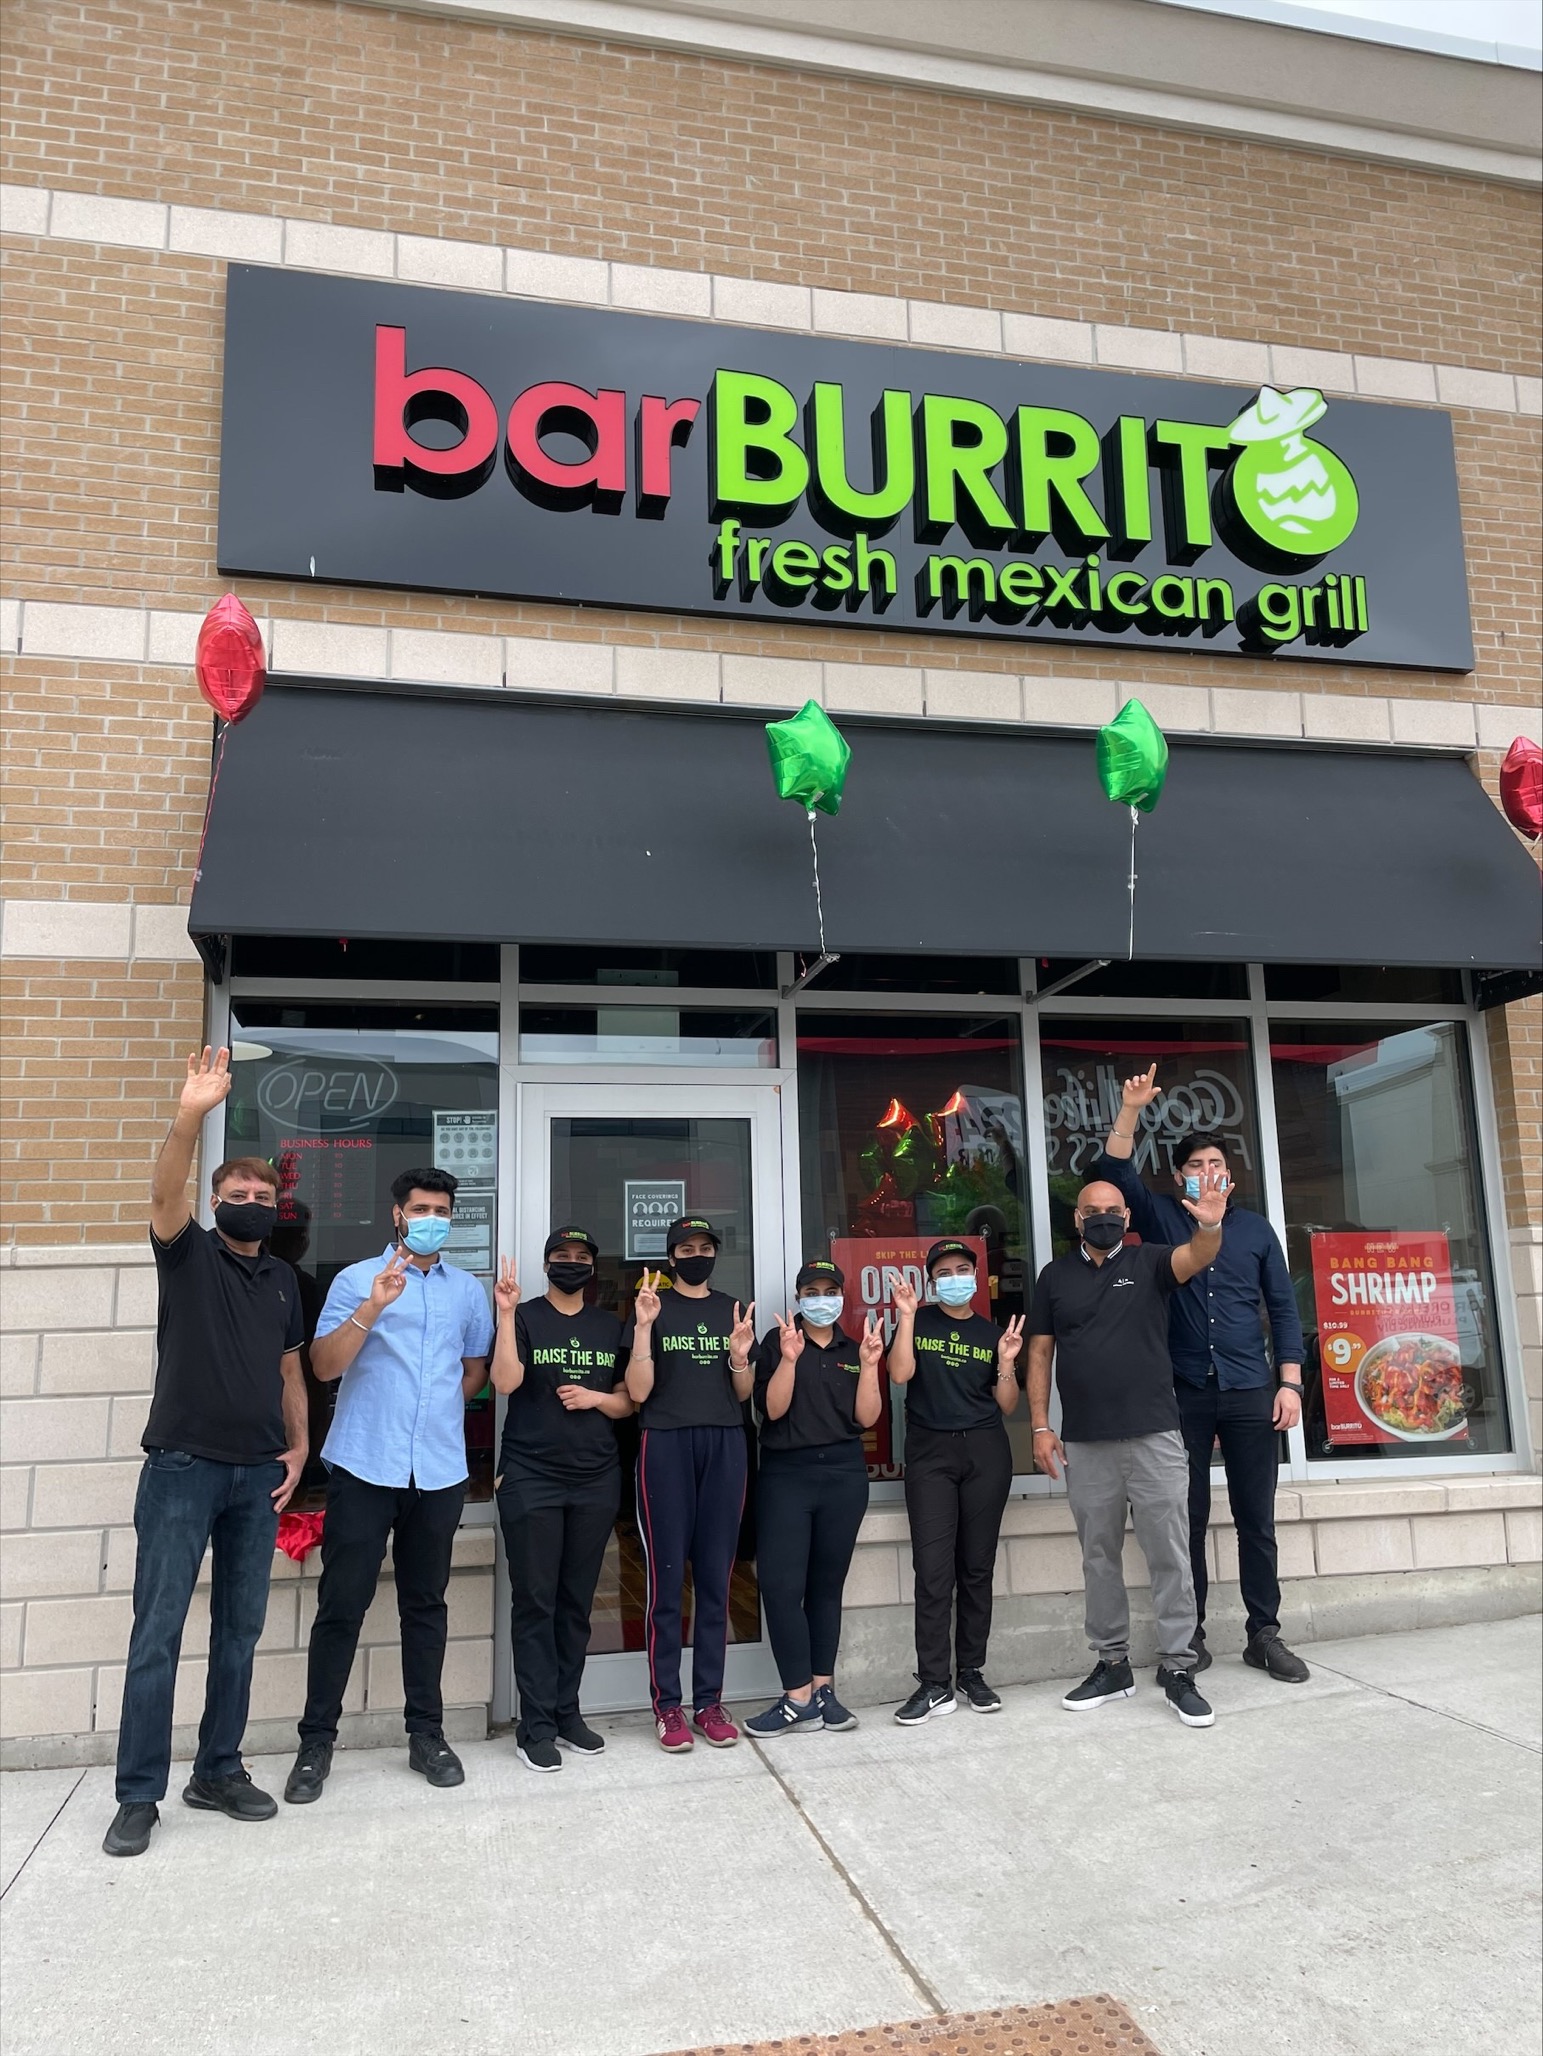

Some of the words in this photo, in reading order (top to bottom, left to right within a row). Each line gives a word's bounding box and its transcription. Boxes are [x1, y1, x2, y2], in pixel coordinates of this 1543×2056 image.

[716, 518, 900, 594] fresh
[929, 554, 1235, 622] mexican
[1257, 573, 1370, 642] grill
[265, 1071, 385, 1111] OPEN
[280, 1139, 329, 1149] BUSINESS
[333, 1138, 373, 1149] HOURS
[279, 1202, 294, 1210] SAT
[279, 1212, 298, 1220] SUN
[632, 1219, 677, 1228] REQUIRE
[1366, 1242, 1397, 1253] NEW
[875, 1251, 896, 1260] SKIP
[899, 1251, 917, 1259] THE
[1330, 1257, 1378, 1269] BANG
[1386, 1256, 1434, 1269] BANG
[861, 1265, 942, 1304] ORD
[1331, 1271, 1437, 1305] SHRIMP
[1323, 1322, 1348, 1330] $10.99
[662, 1335, 696, 1352] RAISE
[698, 1336, 721, 1351] THE
[915, 1336, 946, 1352] RAISE
[948, 1341, 970, 1357] THE
[973, 1346, 994, 1364] BAR
[533, 1348, 568, 1365] RAISE
[570, 1350, 593, 1366] THE
[596, 1351, 616, 1368] BAR
